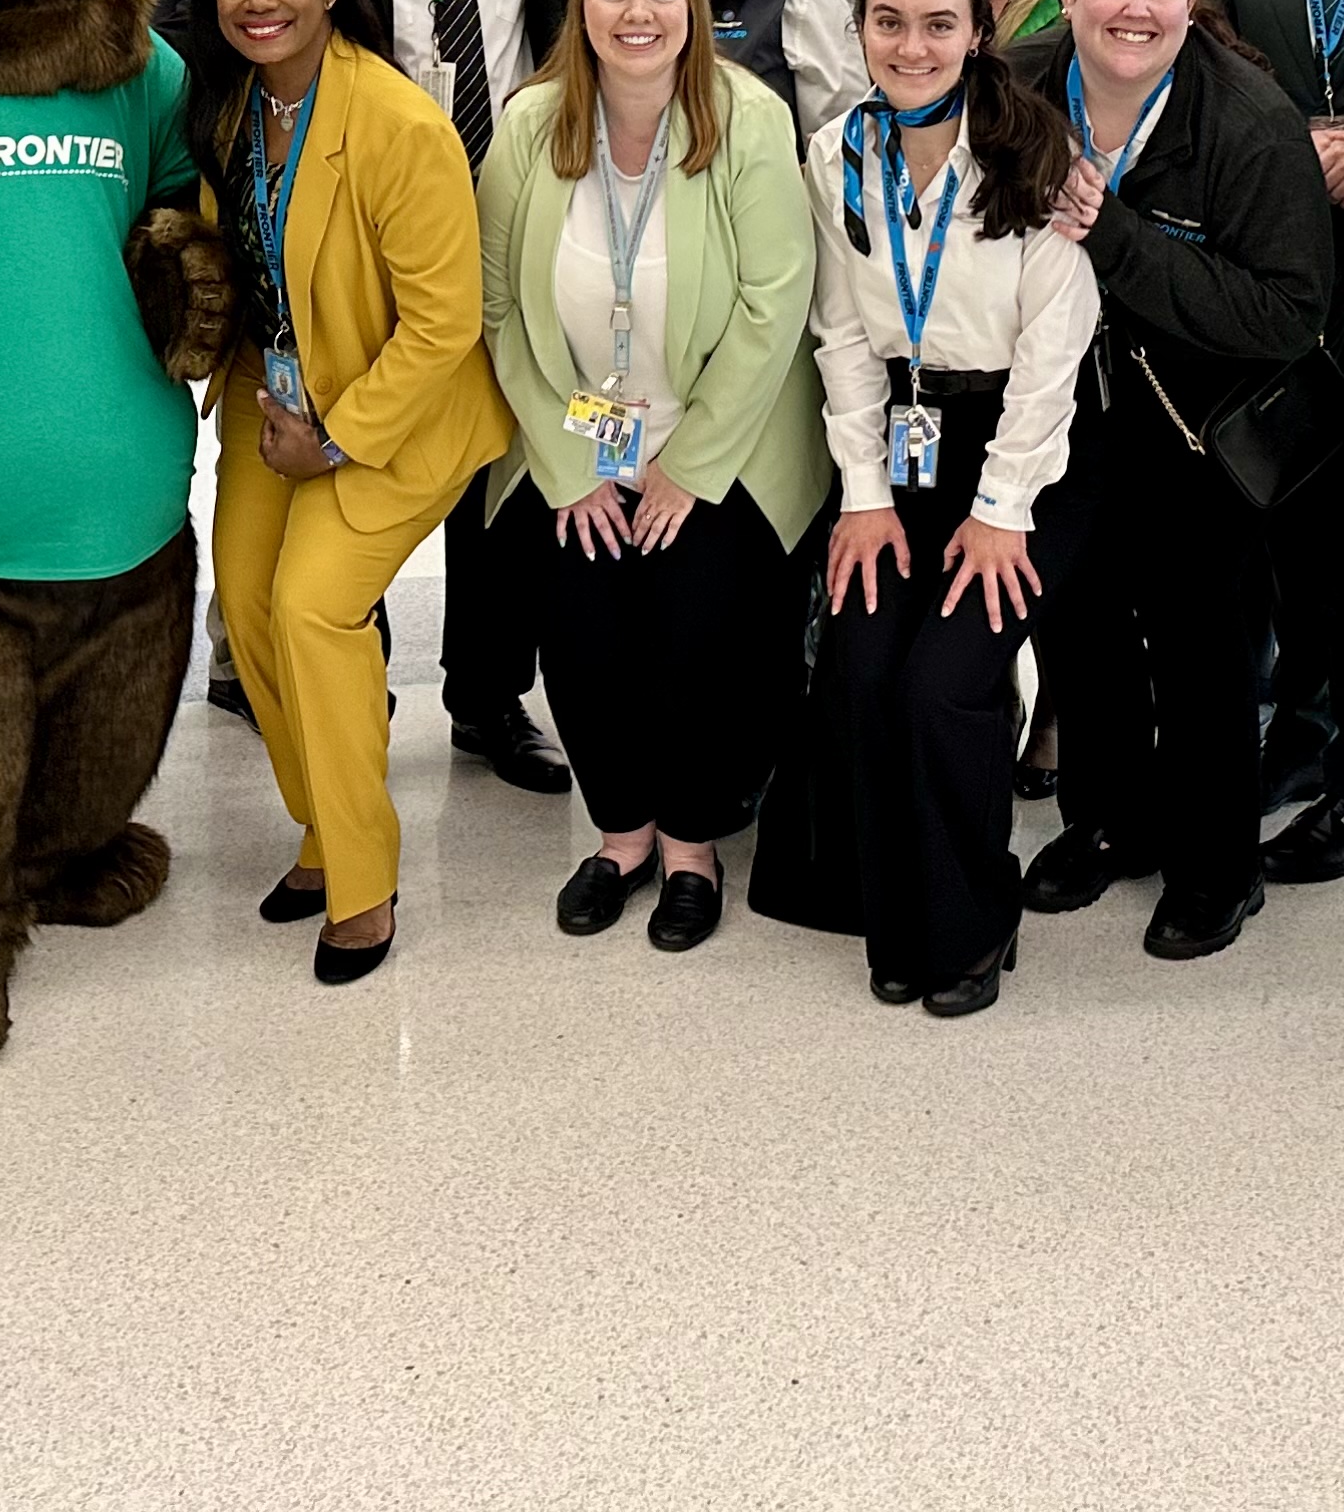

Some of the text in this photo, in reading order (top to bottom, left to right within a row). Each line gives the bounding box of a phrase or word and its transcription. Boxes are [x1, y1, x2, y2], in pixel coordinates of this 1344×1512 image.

[885, 171, 898, 224] FRONTIER
[937, 175, 956, 230] FRONTIER
[258, 203, 280, 272] FRONTIER
[896, 261, 915, 316] FRONTIER
[918, 266, 936, 318] FRONTIER
